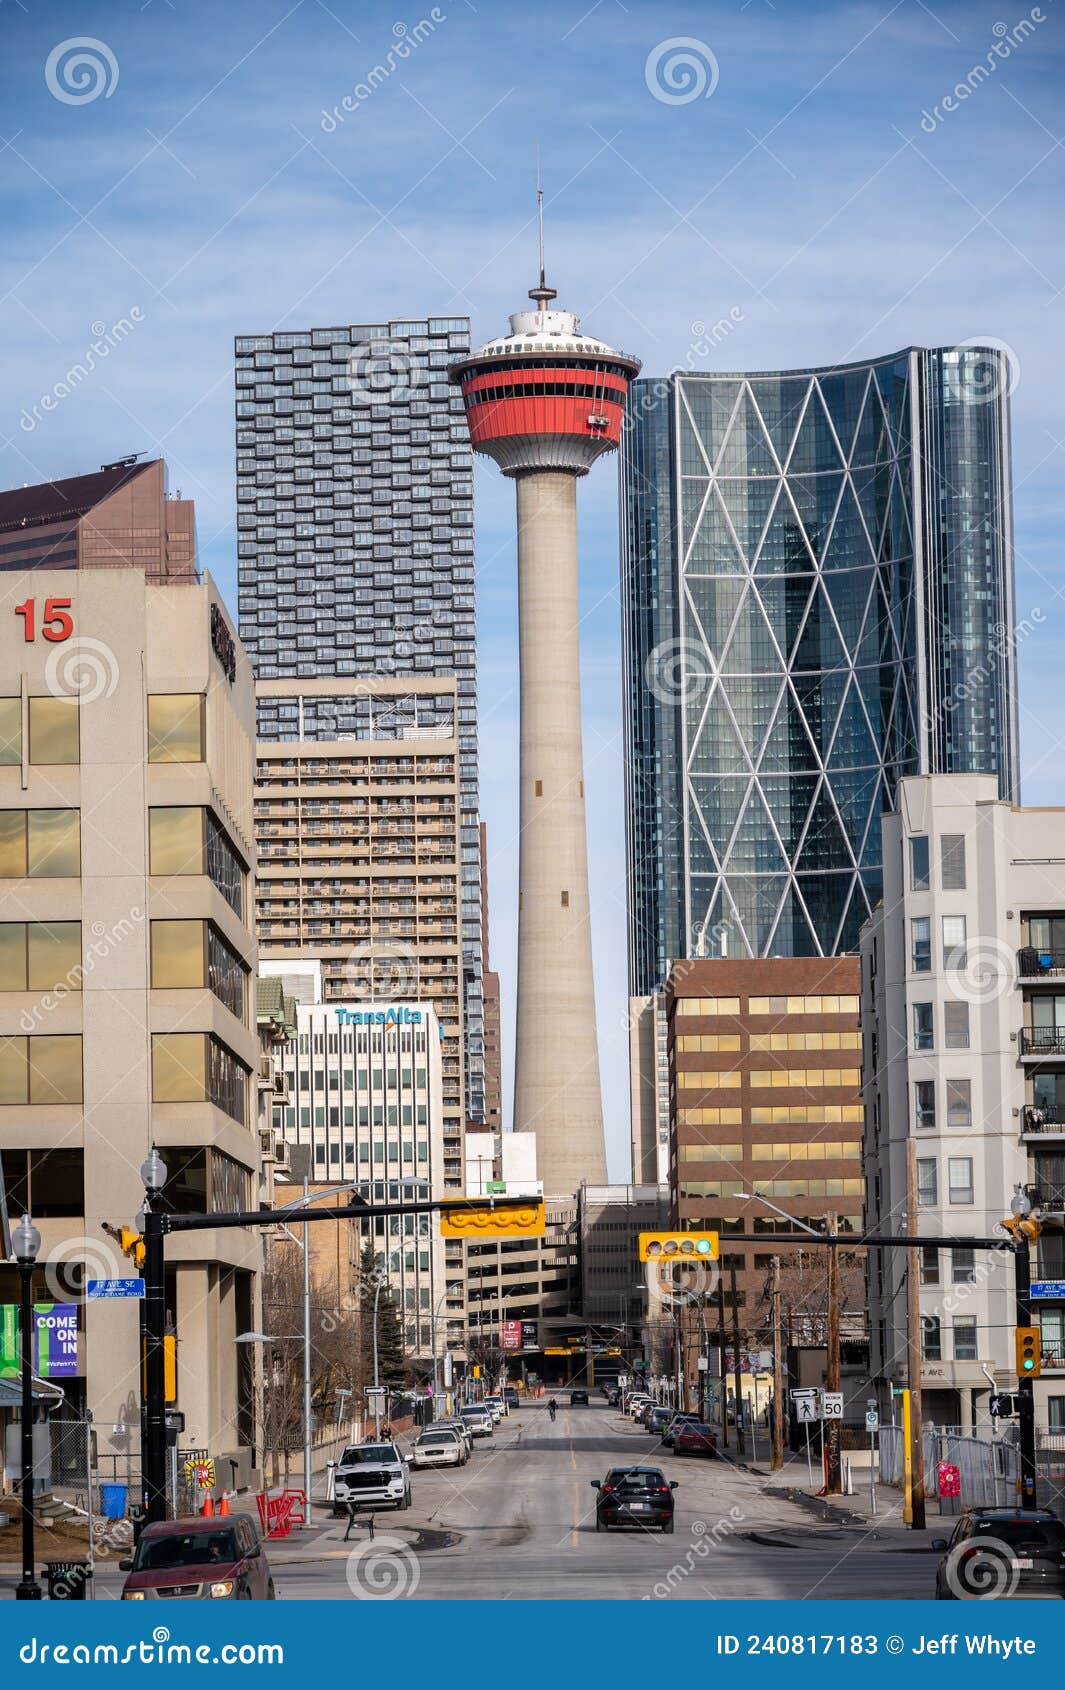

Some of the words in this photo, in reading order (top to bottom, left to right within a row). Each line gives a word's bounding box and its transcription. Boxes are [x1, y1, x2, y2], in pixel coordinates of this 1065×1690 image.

[15, 598, 73, 642] 15
[335, 1007, 421, 1025] TransAlta
[37, 1317, 77, 1328] COME
[57, 1330, 77, 1340] ON
[63, 1342, 77, 1353] IN
[825, 1403, 841, 1414] 50
